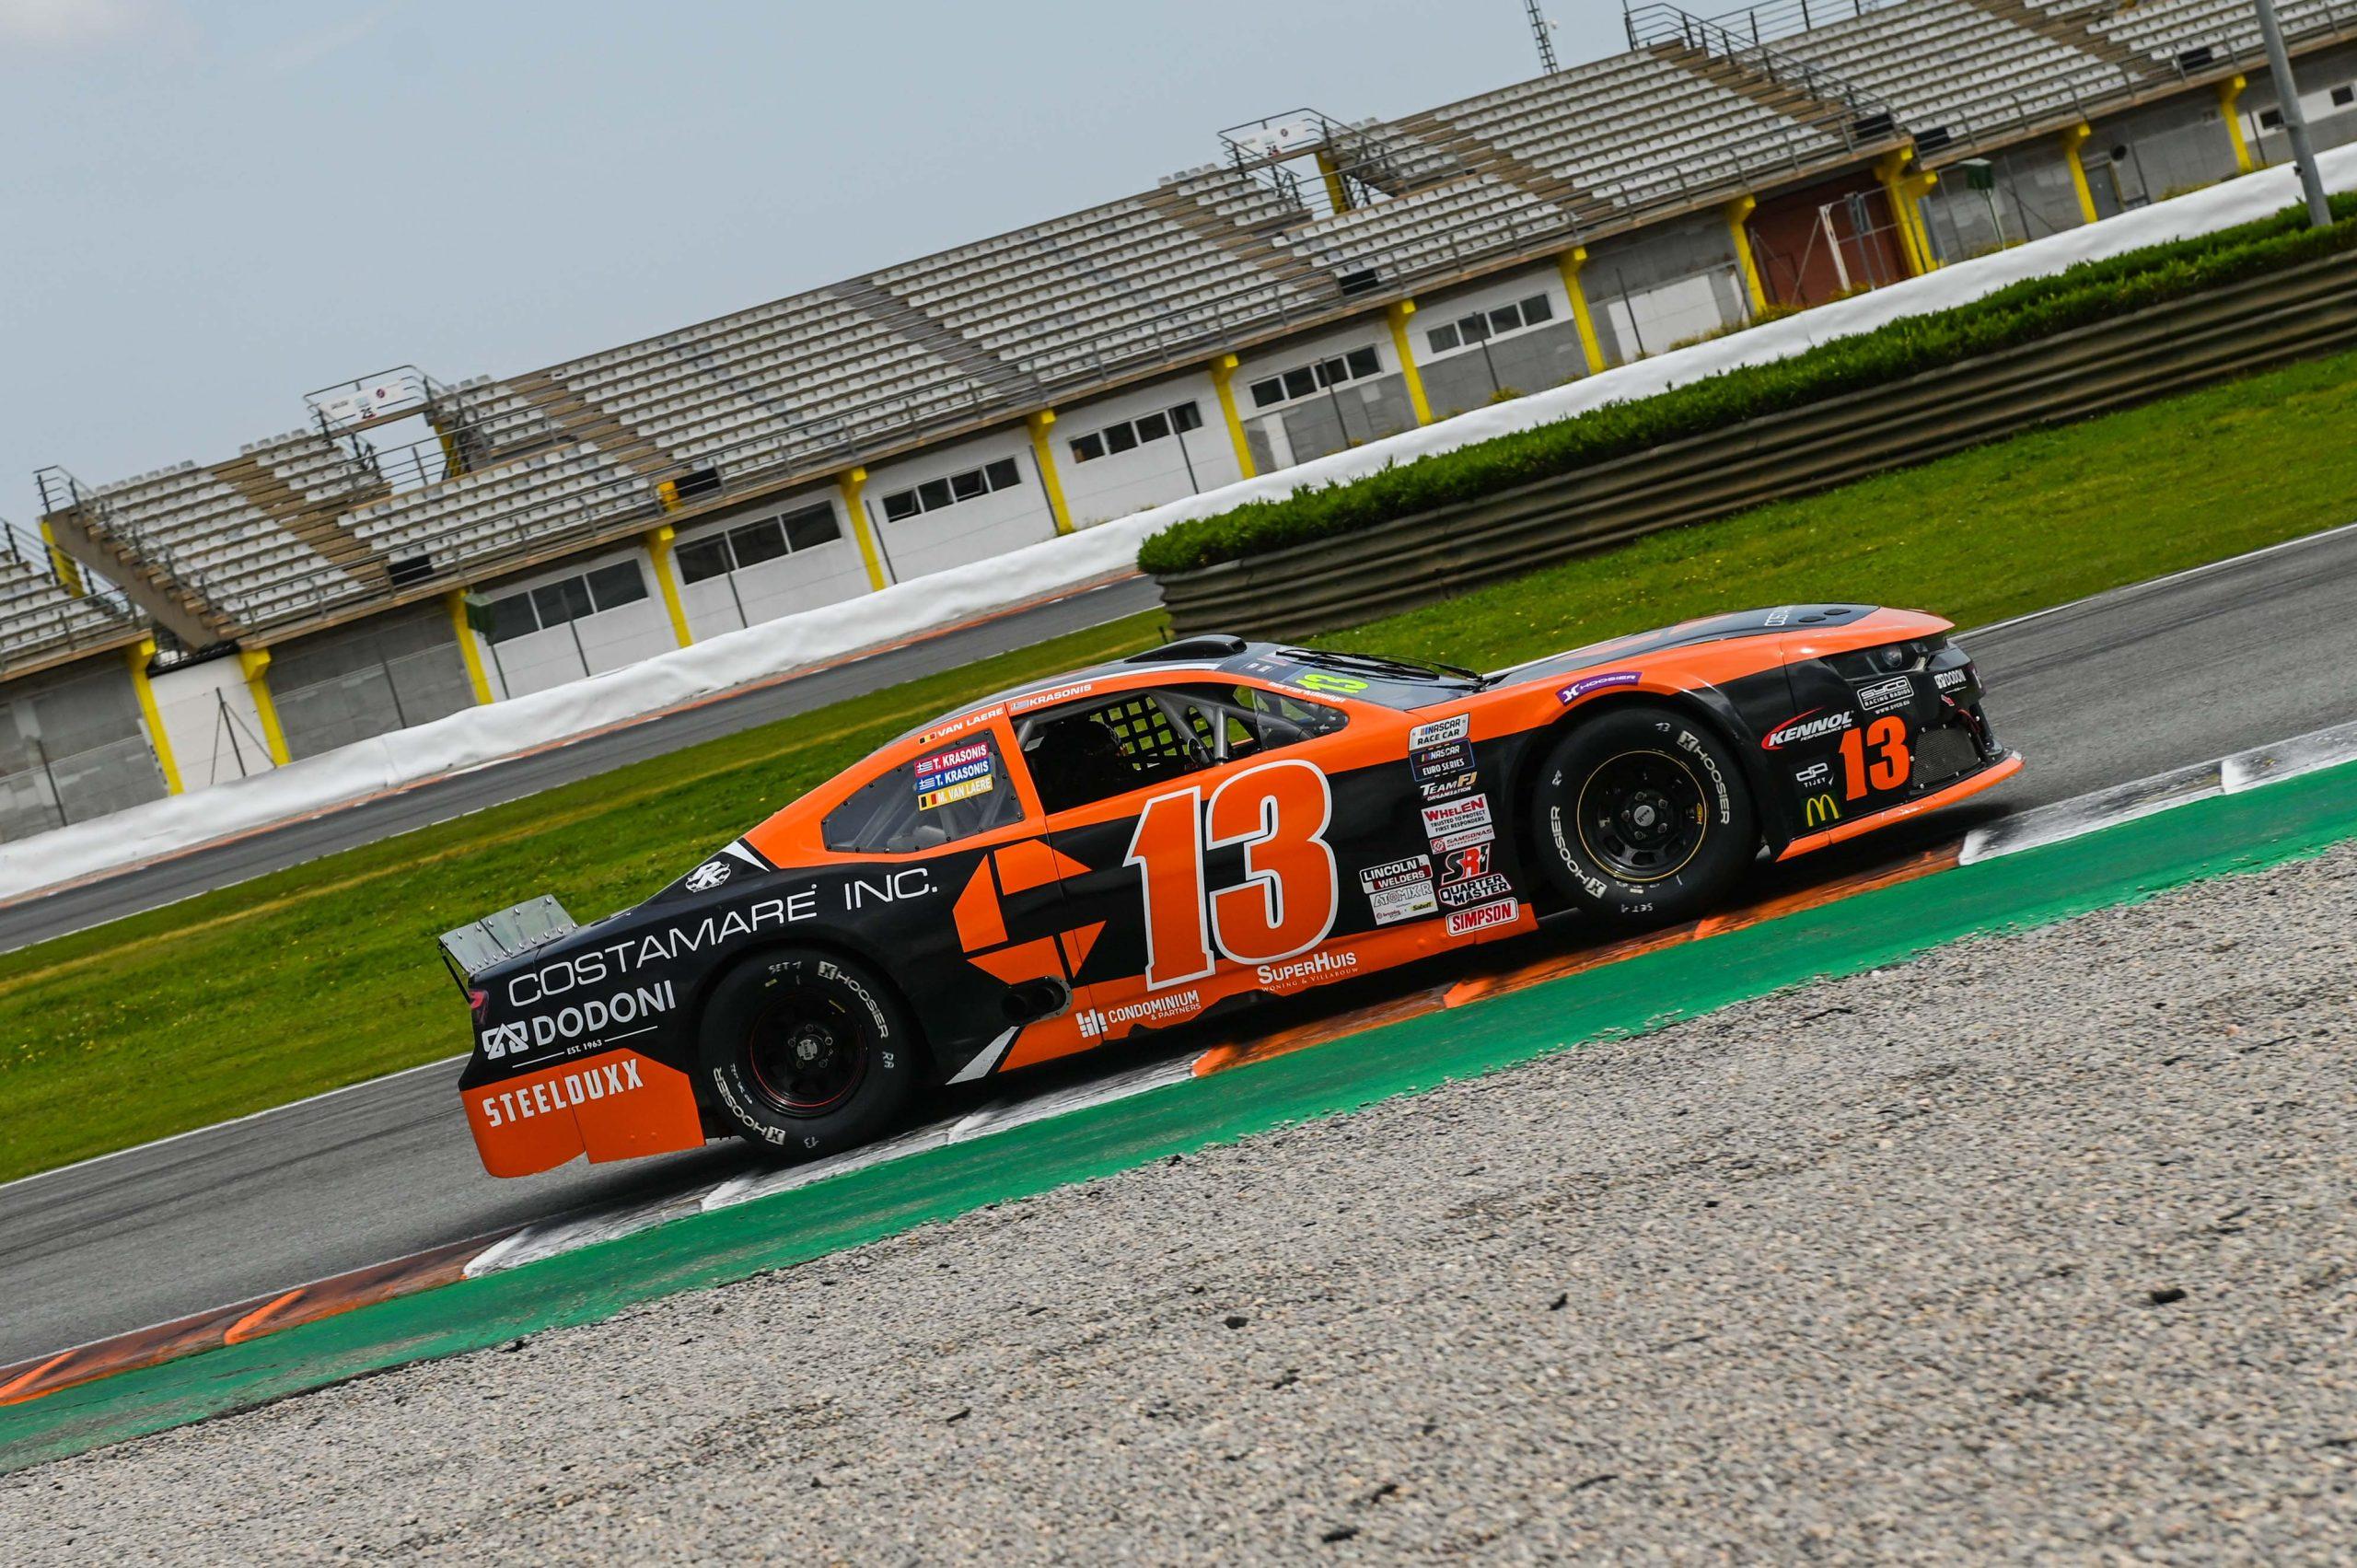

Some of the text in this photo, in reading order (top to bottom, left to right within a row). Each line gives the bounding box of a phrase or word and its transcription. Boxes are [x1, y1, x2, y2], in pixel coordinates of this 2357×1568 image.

[1029, 684, 1093, 706] KRASONIS
[1580, 675, 1636, 690] HOOSIER
[1861, 679, 1908, 700] SYCO
[1864, 689, 1911, 707] RACING RADIOS
[937, 707, 1004, 738] VAN LAERE
[1426, 718, 1461, 734] NASCAR
[1768, 711, 1853, 747] KENNOL
[1418, 728, 1459, 745] RACE CAR
[933, 745, 987, 771] T. KRASONIS
[1429, 745, 1460, 760] NASCAR
[1838, 714, 1910, 802] 13
[935, 761, 989, 787] T. KRASONIS
[1422, 758, 1465, 775] EURO SERIES
[937, 777, 992, 803] M. VAN LAERE
[1693, 744, 1730, 825] HOOSIER
[1424, 796, 1485, 822] WHELEN
[1431, 817, 1454, 828] TRUSTED
[1462, 810, 1485, 819] PROTECT
[1451, 816, 1485, 829] RESPONDERS
[1446, 829, 1493, 844] SAMSONAS
[1550, 805, 1591, 886] HOOSIER
[1121, 759, 1340, 992] 13
[1364, 859, 1418, 882] LINCOLN
[1378, 870, 1426, 889] WELDERS
[844, 867, 939, 912] INC.
[1440, 875, 1504, 901] QUARTER
[1453, 882, 1509, 904] MASTER
[1452, 902, 1512, 932] SIMPSON
[1261, 979, 1298, 993] WONING
[1310, 967, 1359, 982] VILLABOUW
[531, 979, 677, 1047] DODONI
[835, 970, 889, 1040] HOOSIER
[1108, 989, 1200, 1024] CONDOMINIUM
[1157, 1002, 1202, 1018] PARTNERS
[566, 1039, 603, 1056] EST. 1963
[482, 1058, 644, 1128] STEELDUXX
[713, 1066, 768, 1137] HOOSIER
